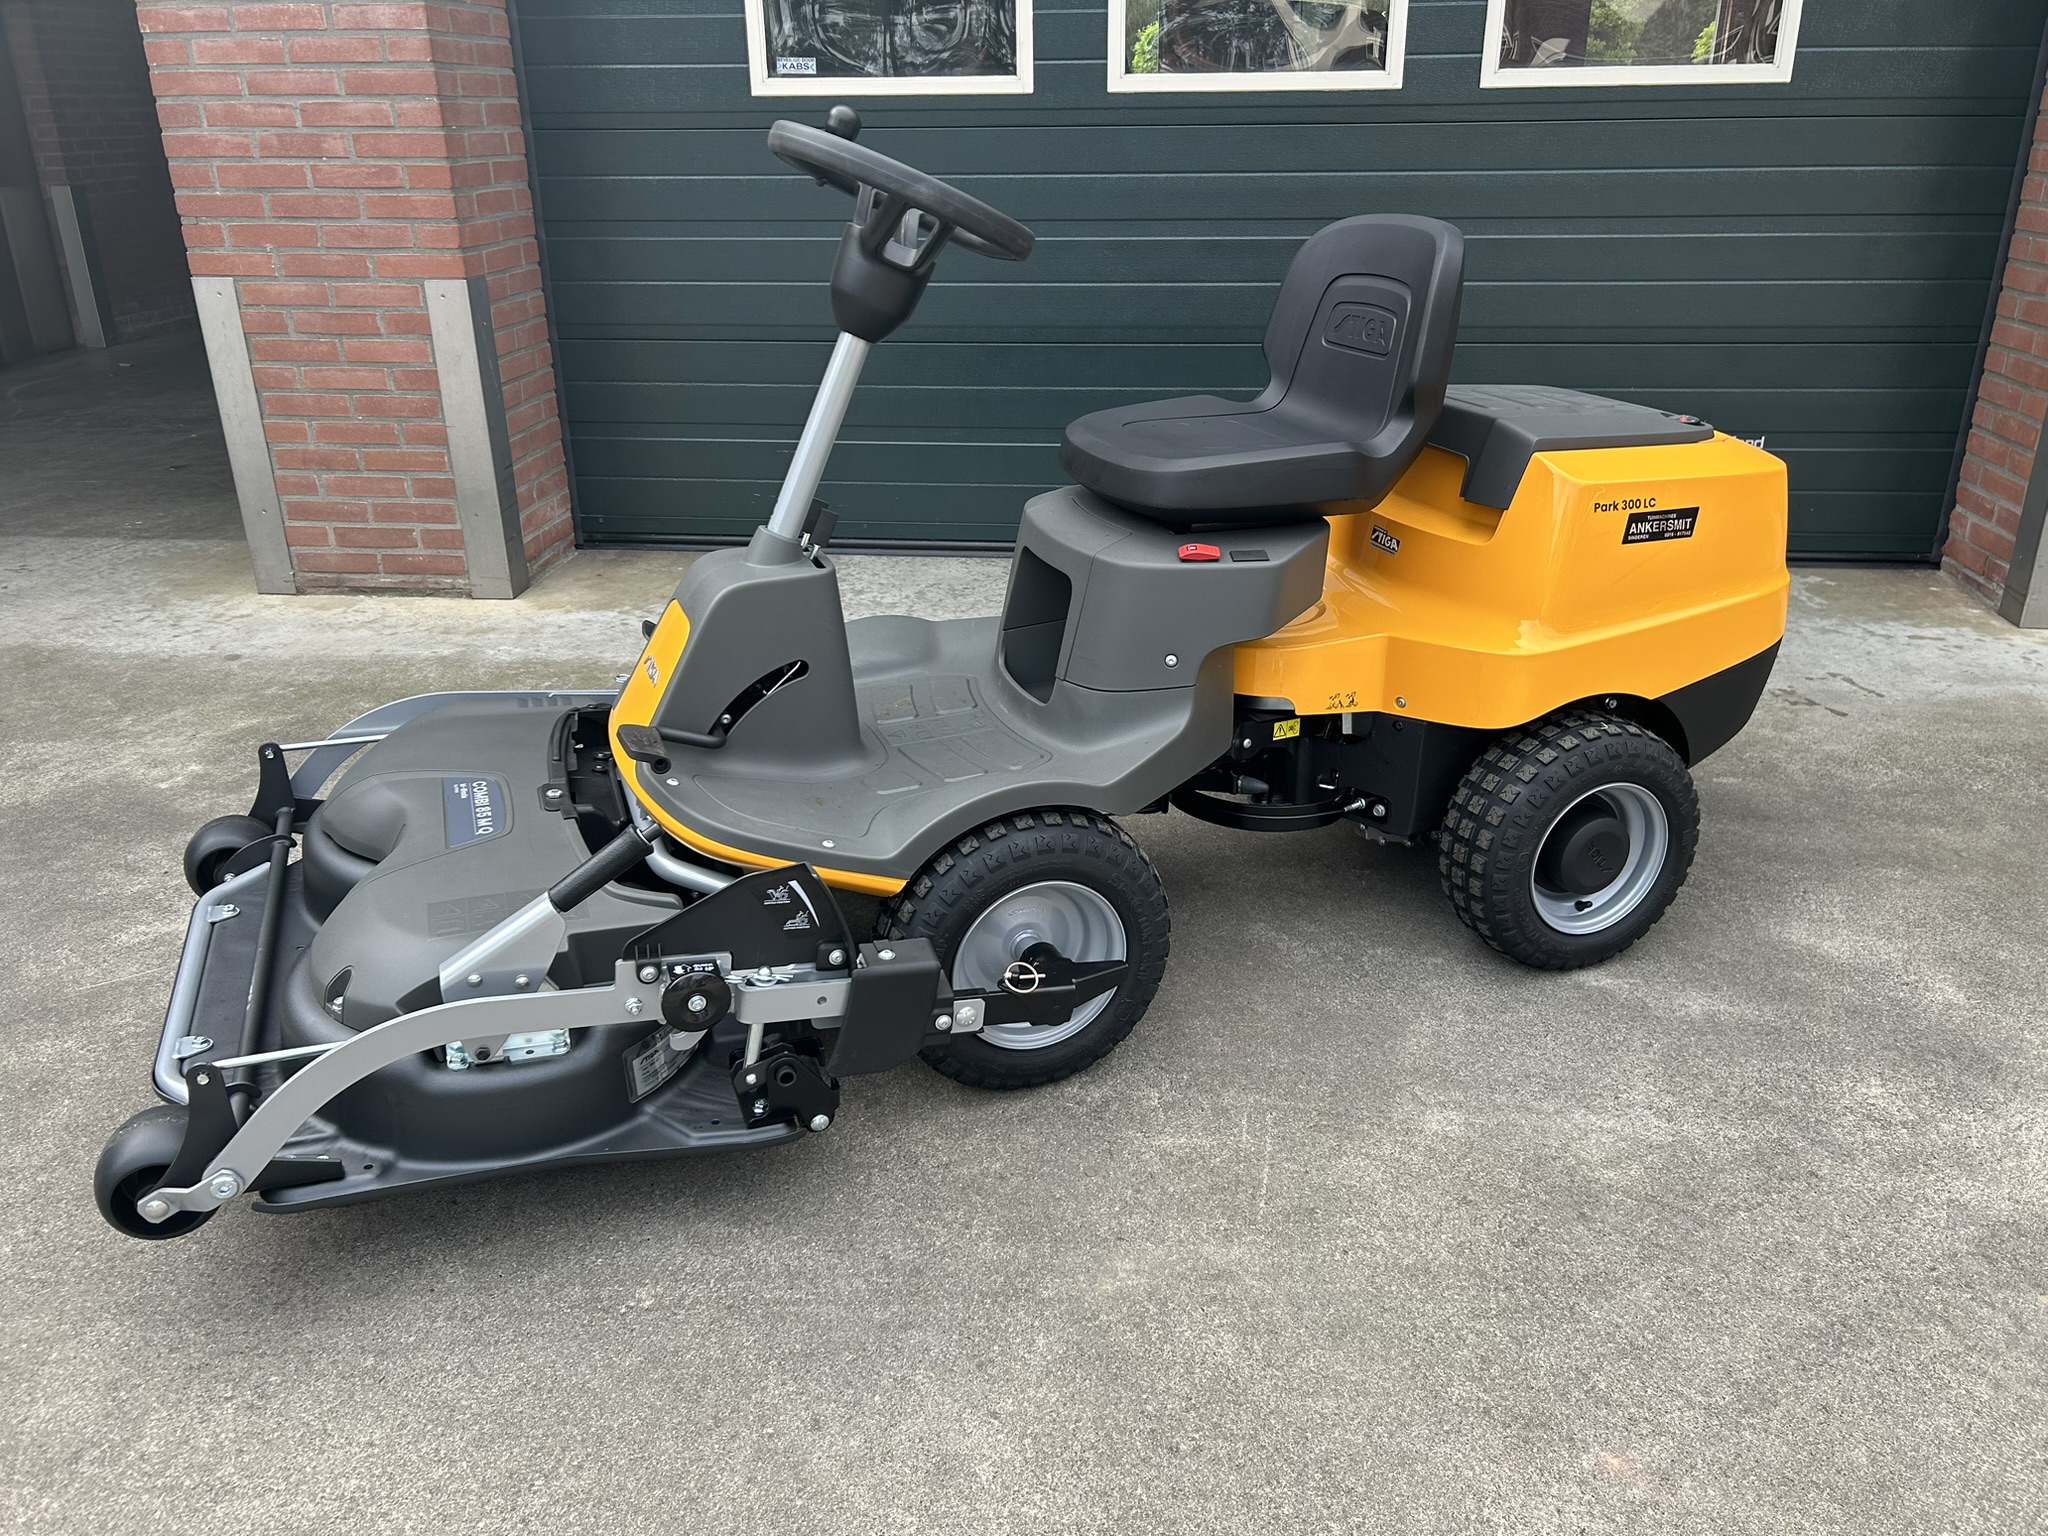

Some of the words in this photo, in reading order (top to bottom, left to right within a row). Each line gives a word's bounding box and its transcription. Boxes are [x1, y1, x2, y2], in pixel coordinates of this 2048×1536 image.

[782, 62, 810, 70] KABS
[1594, 500, 1619, 512] Park
[1621, 499, 1641, 510] 300
[1644, 498, 1656, 508] LC
[1629, 518, 1693, 535] ANKERSMIT
[1371, 530, 1398, 552] STIGA
[472, 781, 490, 807] COMBI
[475, 806, 492, 818] 85
[477, 817, 493, 827] M
[475, 827, 494, 836] Q
